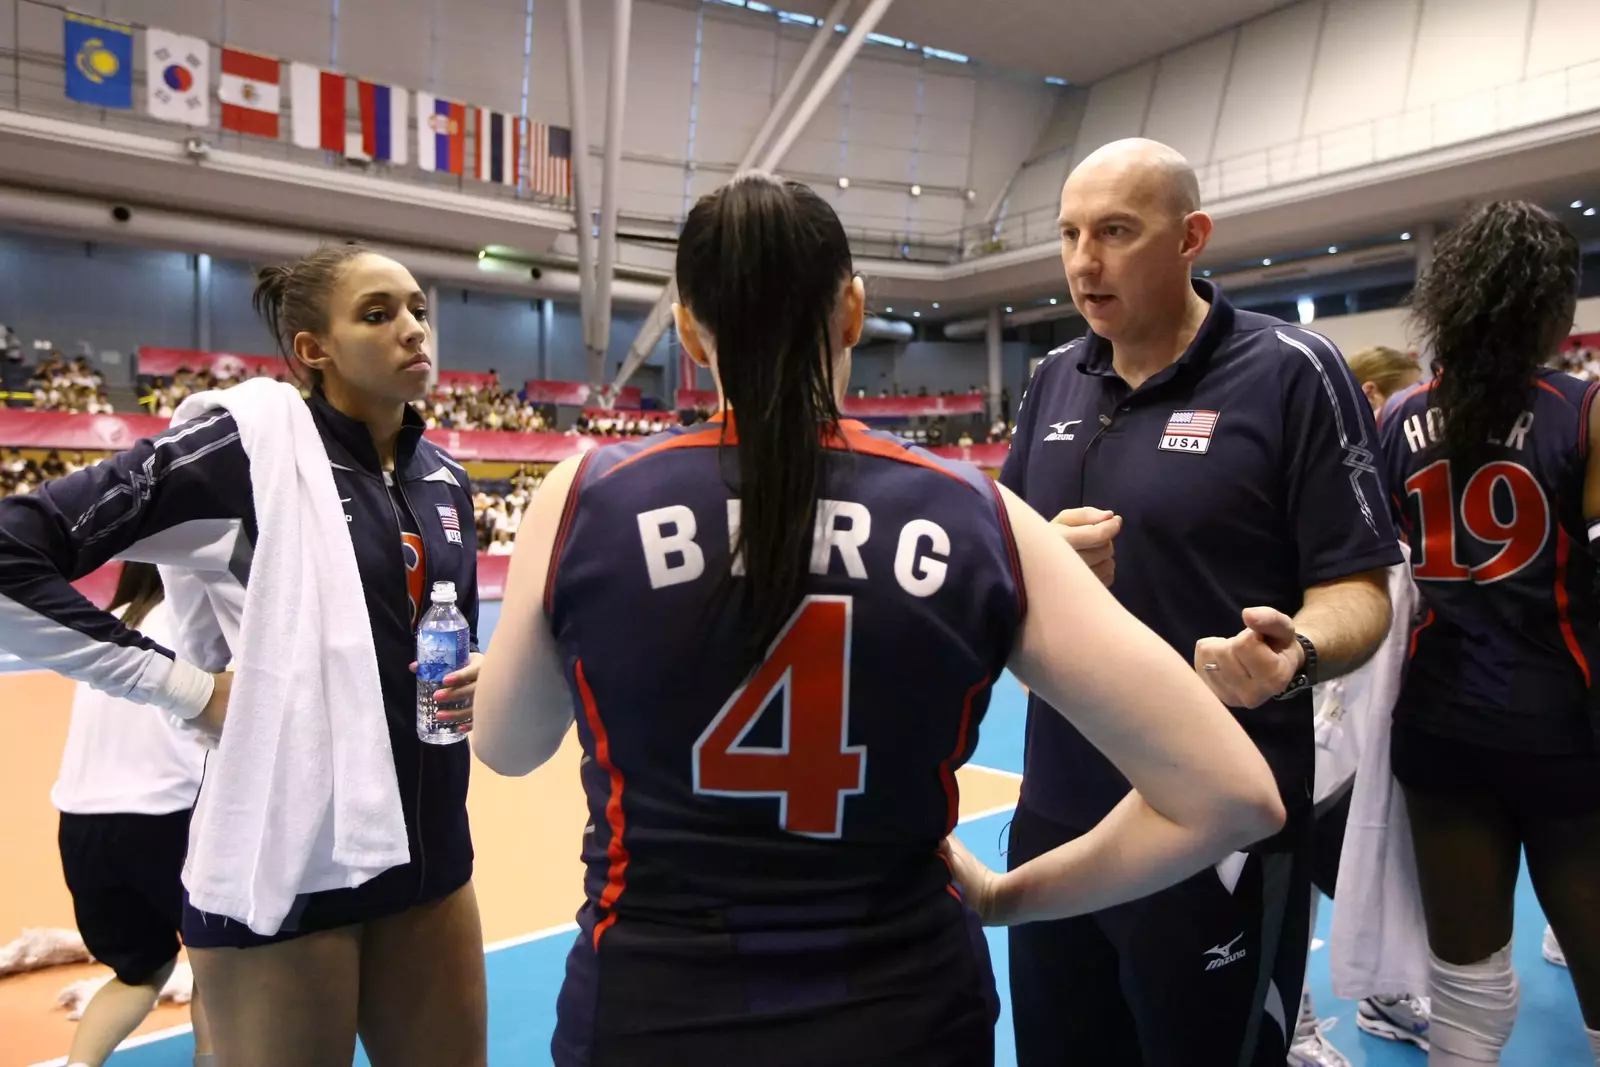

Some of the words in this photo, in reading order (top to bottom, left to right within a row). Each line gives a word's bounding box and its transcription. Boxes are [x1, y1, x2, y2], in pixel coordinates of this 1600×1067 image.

[1168, 438, 1200, 449] USA
[1403, 406, 1534, 453] HOR
[1404, 459, 1550, 586] 19
[692, 594, 867, 839] 4
